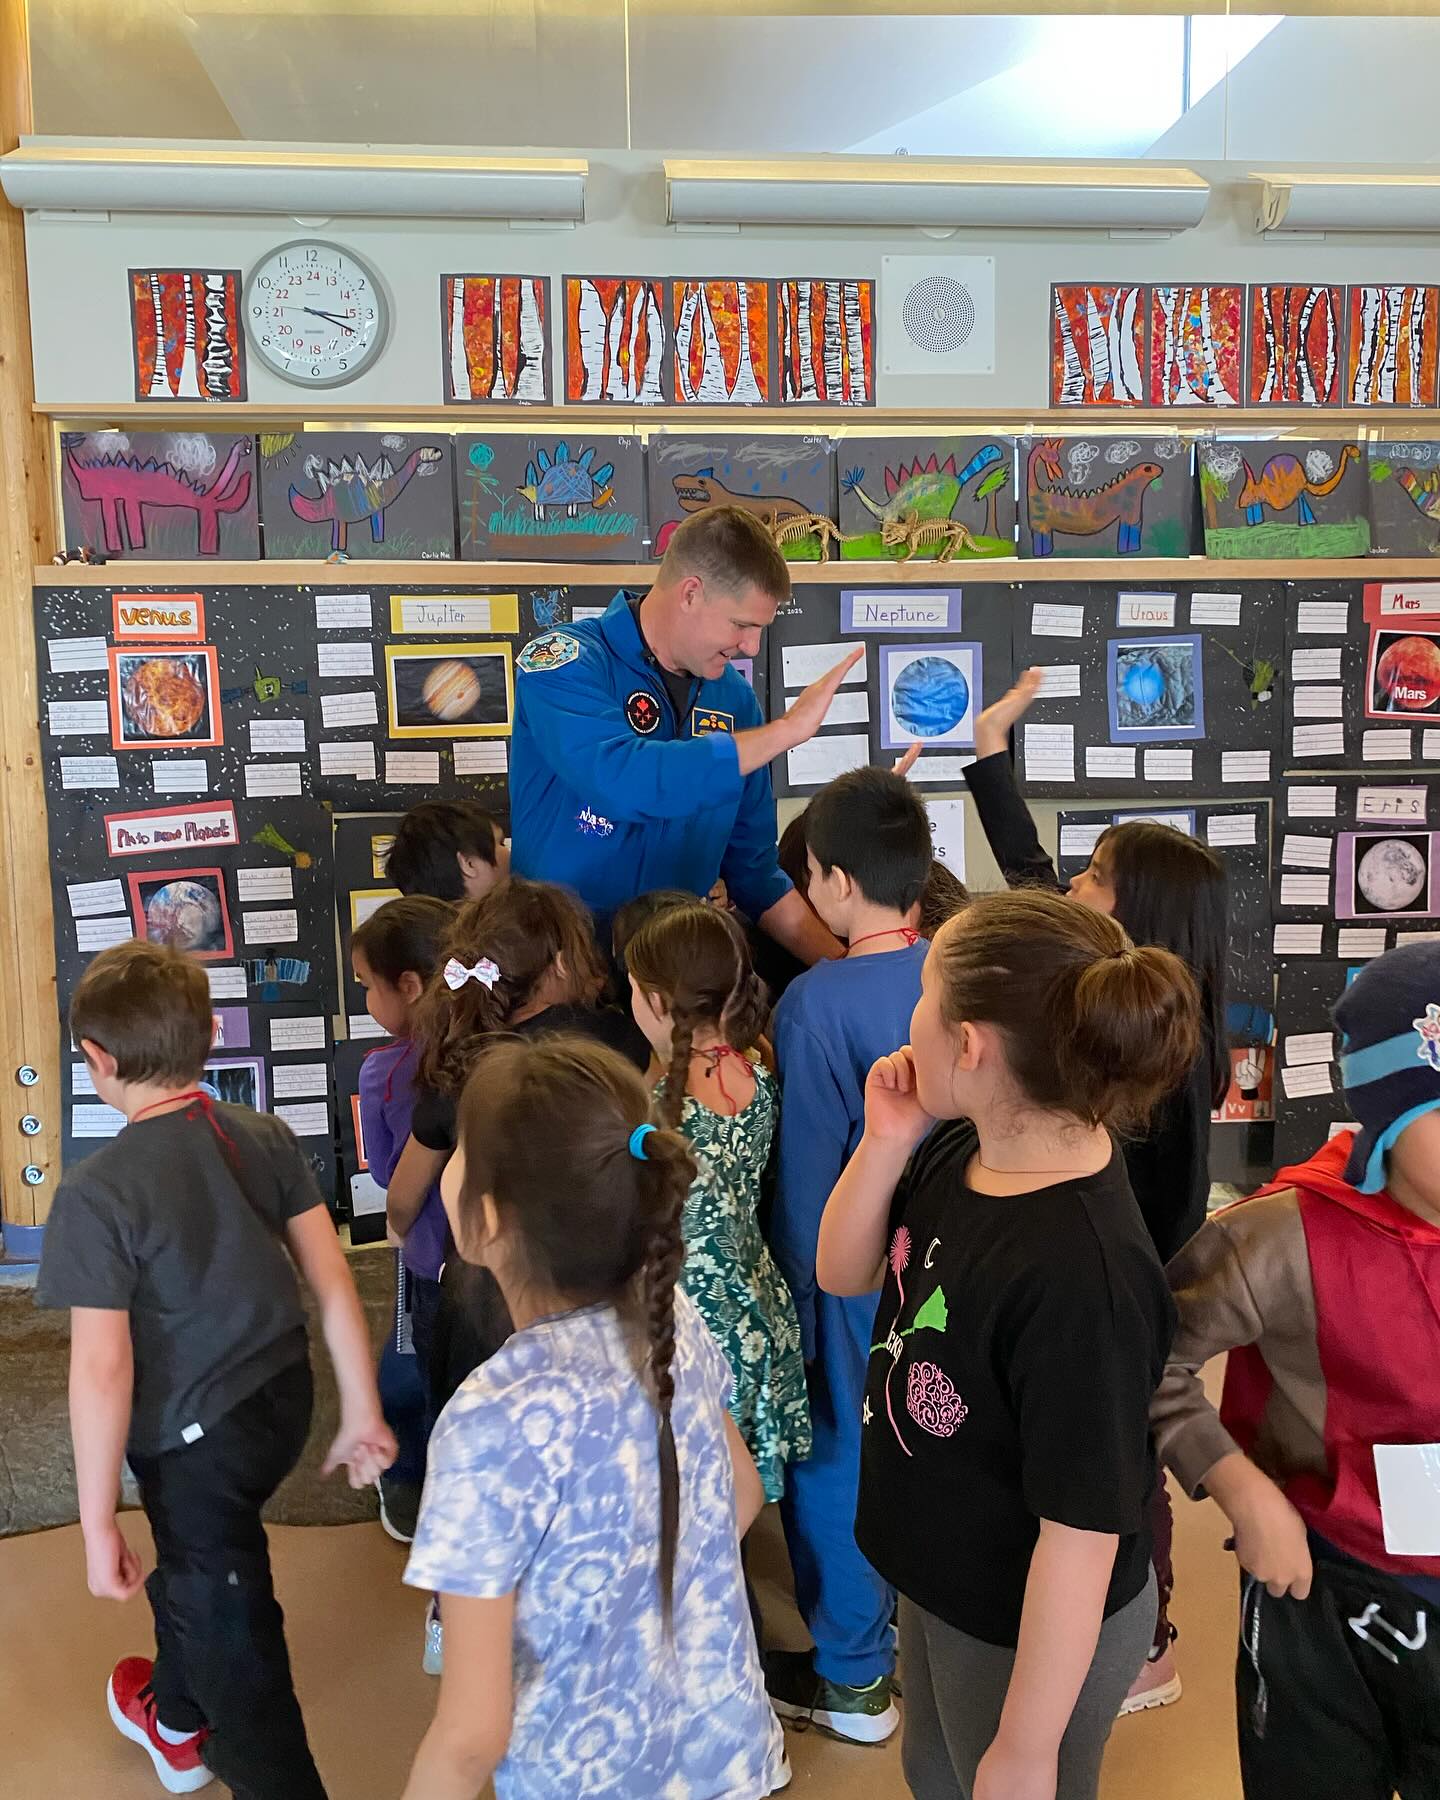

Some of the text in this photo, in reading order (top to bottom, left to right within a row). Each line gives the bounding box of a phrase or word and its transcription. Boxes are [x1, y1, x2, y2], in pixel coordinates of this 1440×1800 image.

[306, 250, 318, 262] 12
[279, 256, 288, 268] 11
[288, 276, 302, 286] 23
[306, 271, 320, 281] 24
[326, 276, 337, 286] 13
[257, 277, 271, 289] 10
[359, 279, 365, 290] 2
[276, 289, 289, 299] 22
[340, 290, 350, 300] 14
[253, 306, 262, 318] 9
[273, 308, 284, 317] 21
[345, 308, 356, 318] 15
[366, 308, 374, 320] 3
[278, 325, 292, 335] 20
[262, 335, 271, 347] 8
[292, 338, 303, 349] 19
[310, 345, 321, 355] 18
[285, 358, 291, 370] 7
[339, 359, 348, 370] 5
[311, 364, 320, 376] 6
[1392, 593, 1420, 610] Mars
[865, 604, 940, 626] Neptune
[1395, 686, 1426, 700] Mars
